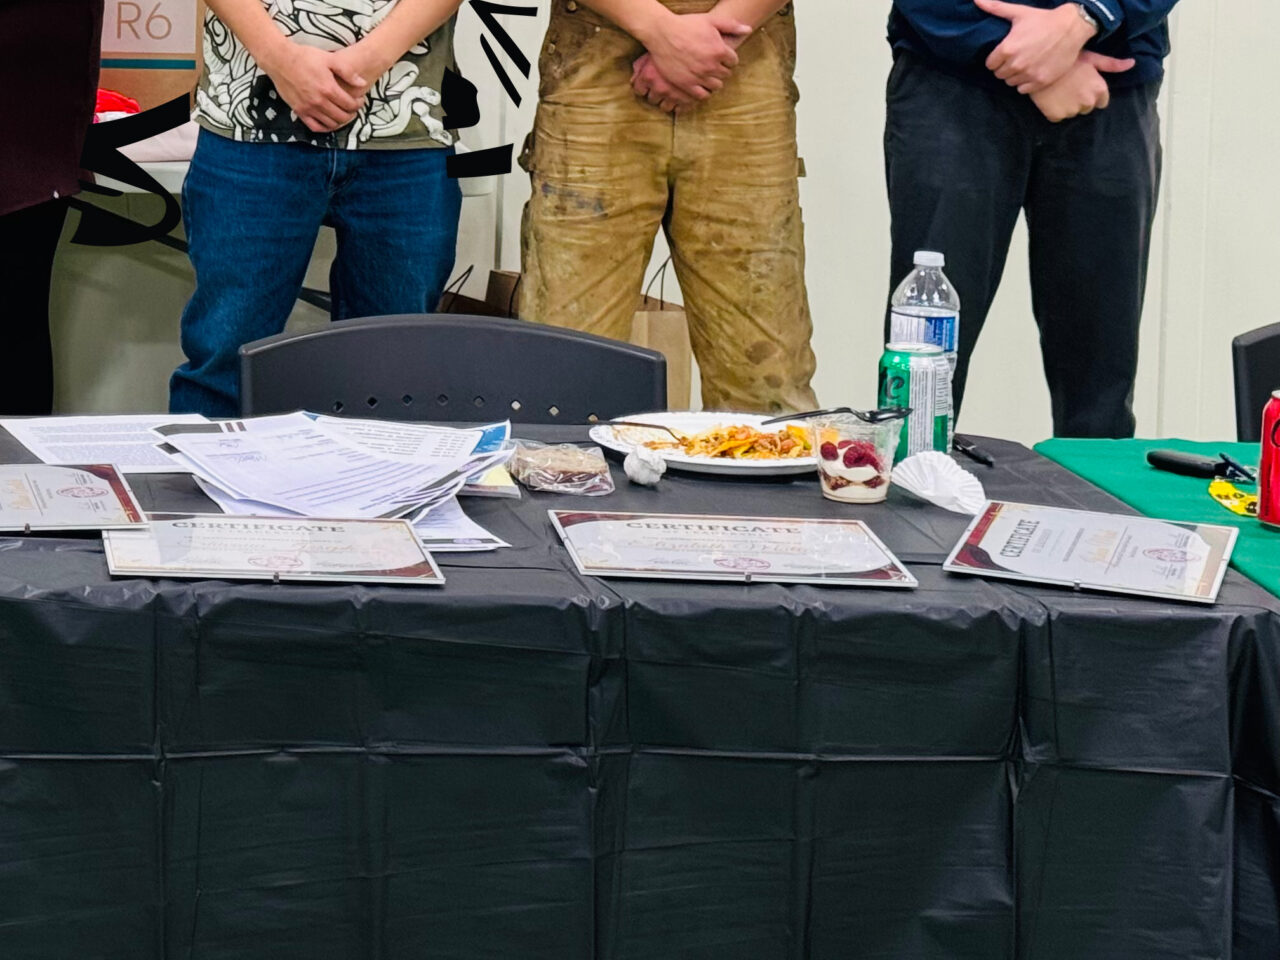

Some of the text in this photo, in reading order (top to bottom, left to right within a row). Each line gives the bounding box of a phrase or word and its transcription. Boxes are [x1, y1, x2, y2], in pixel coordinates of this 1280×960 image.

[116, 1, 173, 41] R6
[171, 521, 345, 533] CERTIFICATE
[626, 522, 801, 534] CERTIFICATE
[999, 519, 1041, 558] CERTIFICATE
